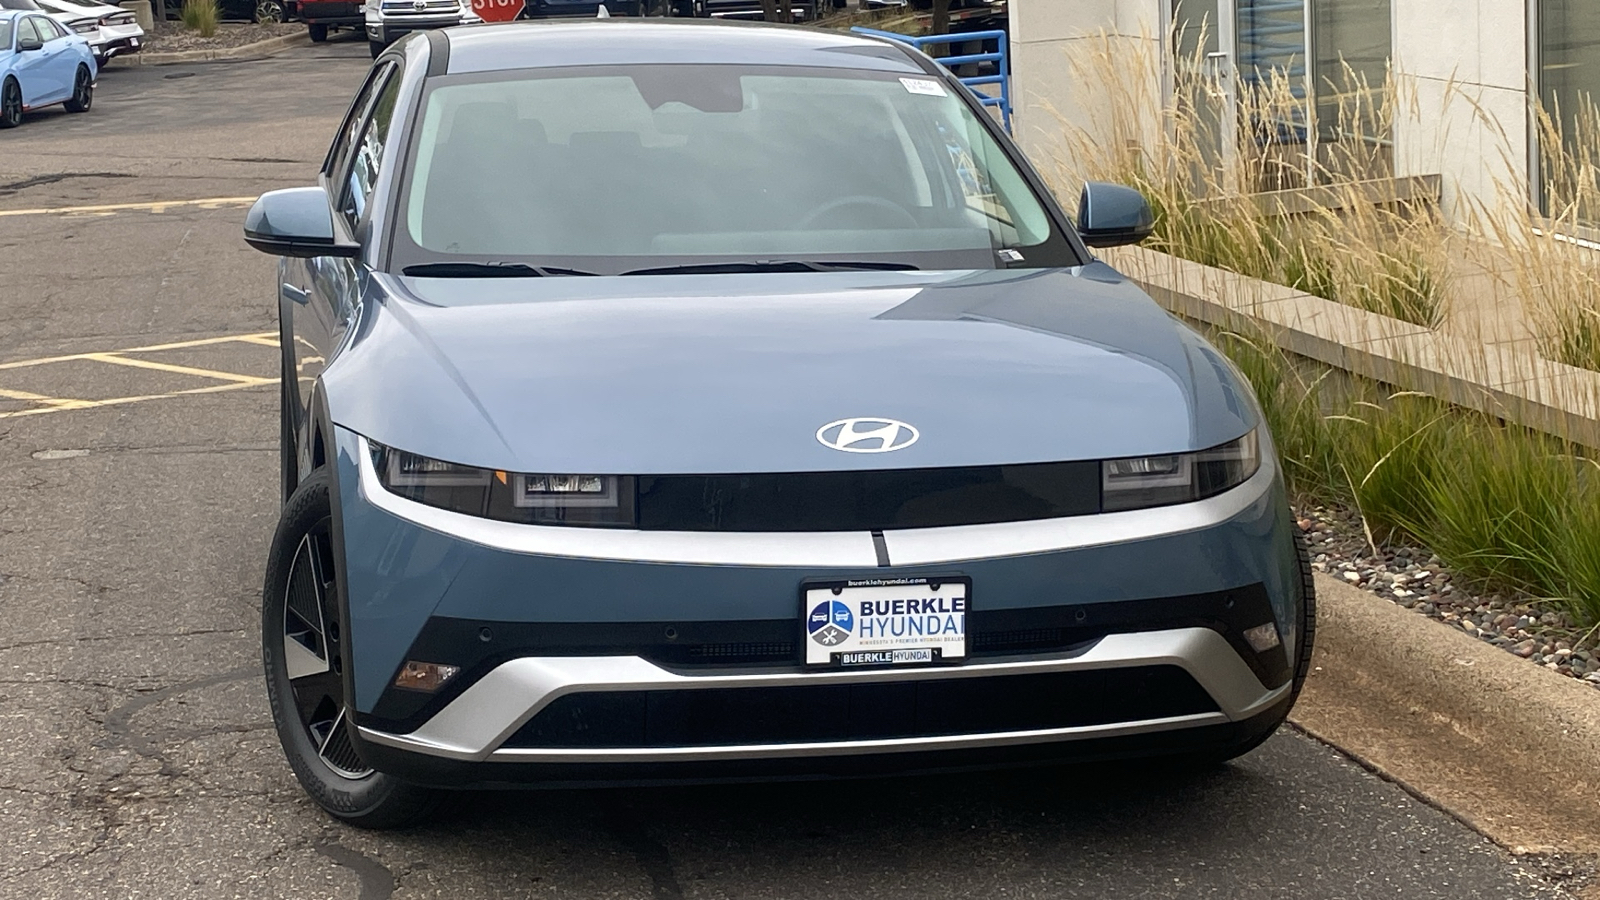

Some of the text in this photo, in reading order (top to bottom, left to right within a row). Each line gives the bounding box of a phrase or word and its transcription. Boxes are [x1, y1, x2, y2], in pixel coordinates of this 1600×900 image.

[848, 578, 927, 587] buerklehyundai.com
[860, 597, 964, 617] BUERKLE
[859, 615, 964, 638] HYUNDAI
[843, 650, 930, 664] BUERKLE HYUNDAI
